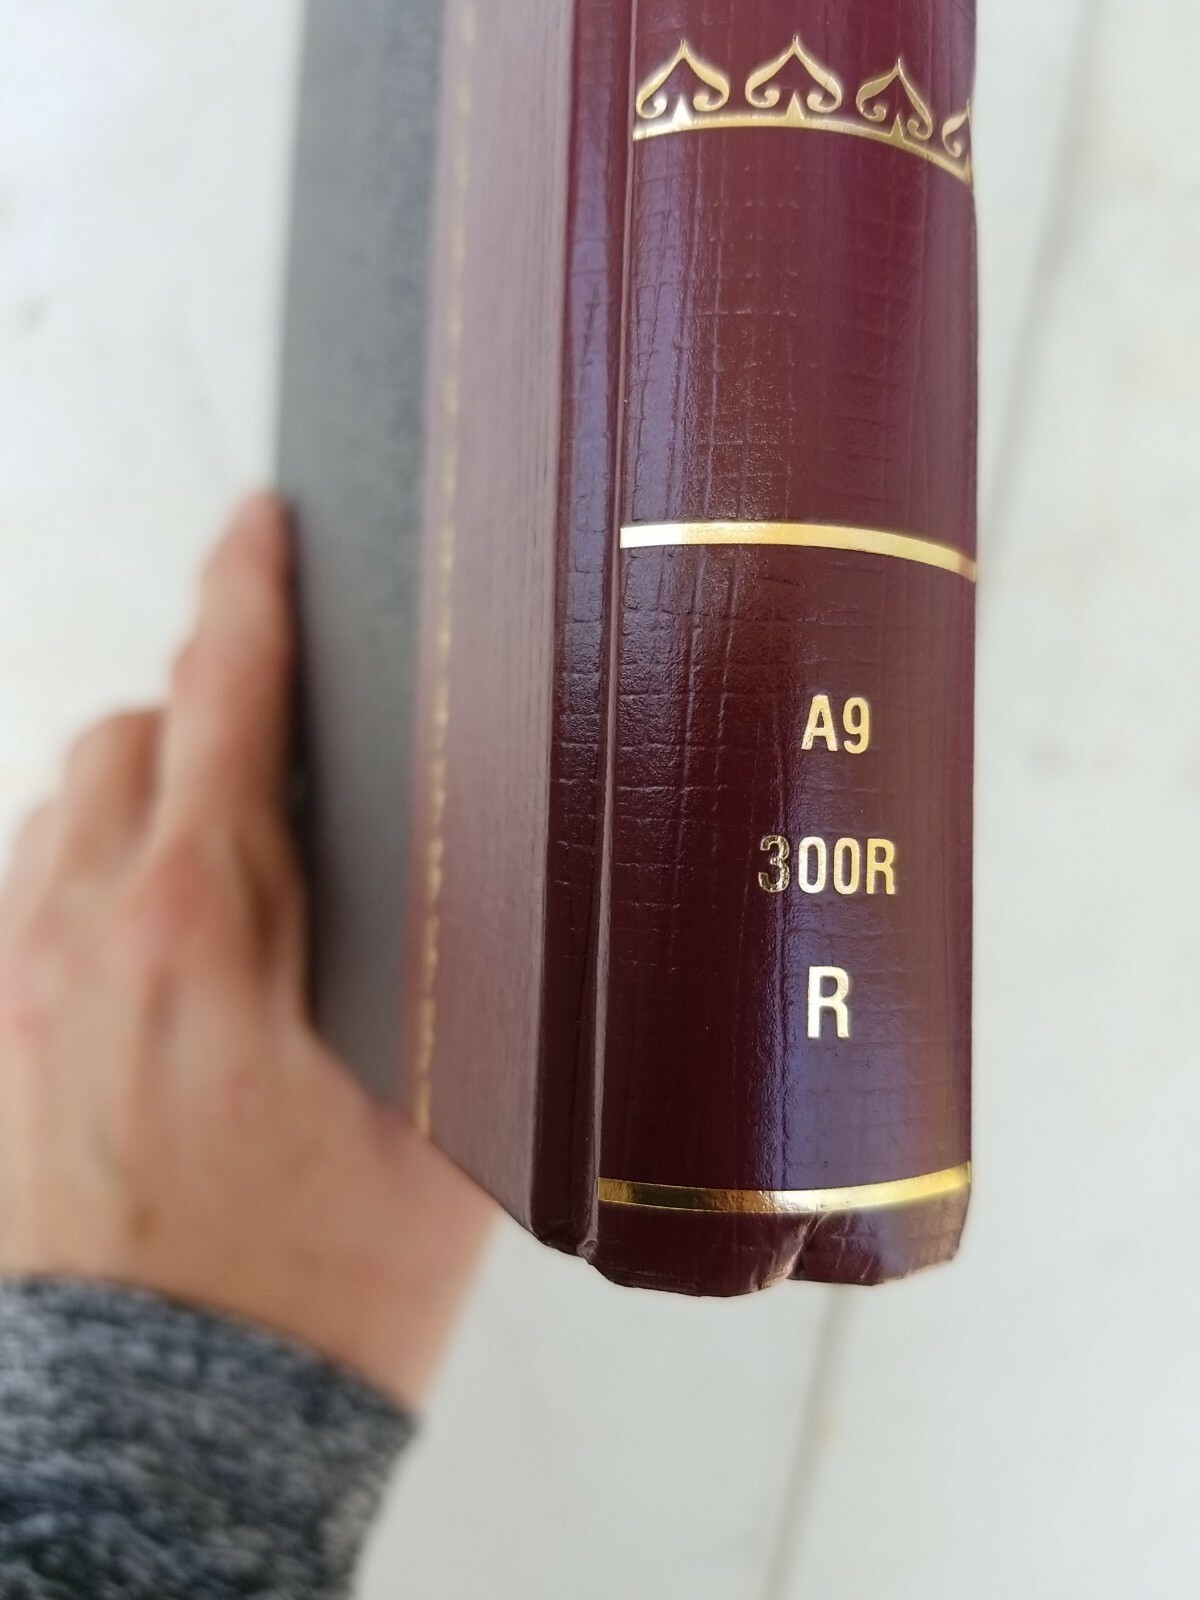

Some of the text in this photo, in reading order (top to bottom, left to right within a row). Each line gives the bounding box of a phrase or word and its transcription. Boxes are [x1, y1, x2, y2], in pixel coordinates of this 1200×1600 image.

[801, 694, 870, 754] A9
[758, 835, 895, 895] 300R
[806, 965, 849, 1038] R
